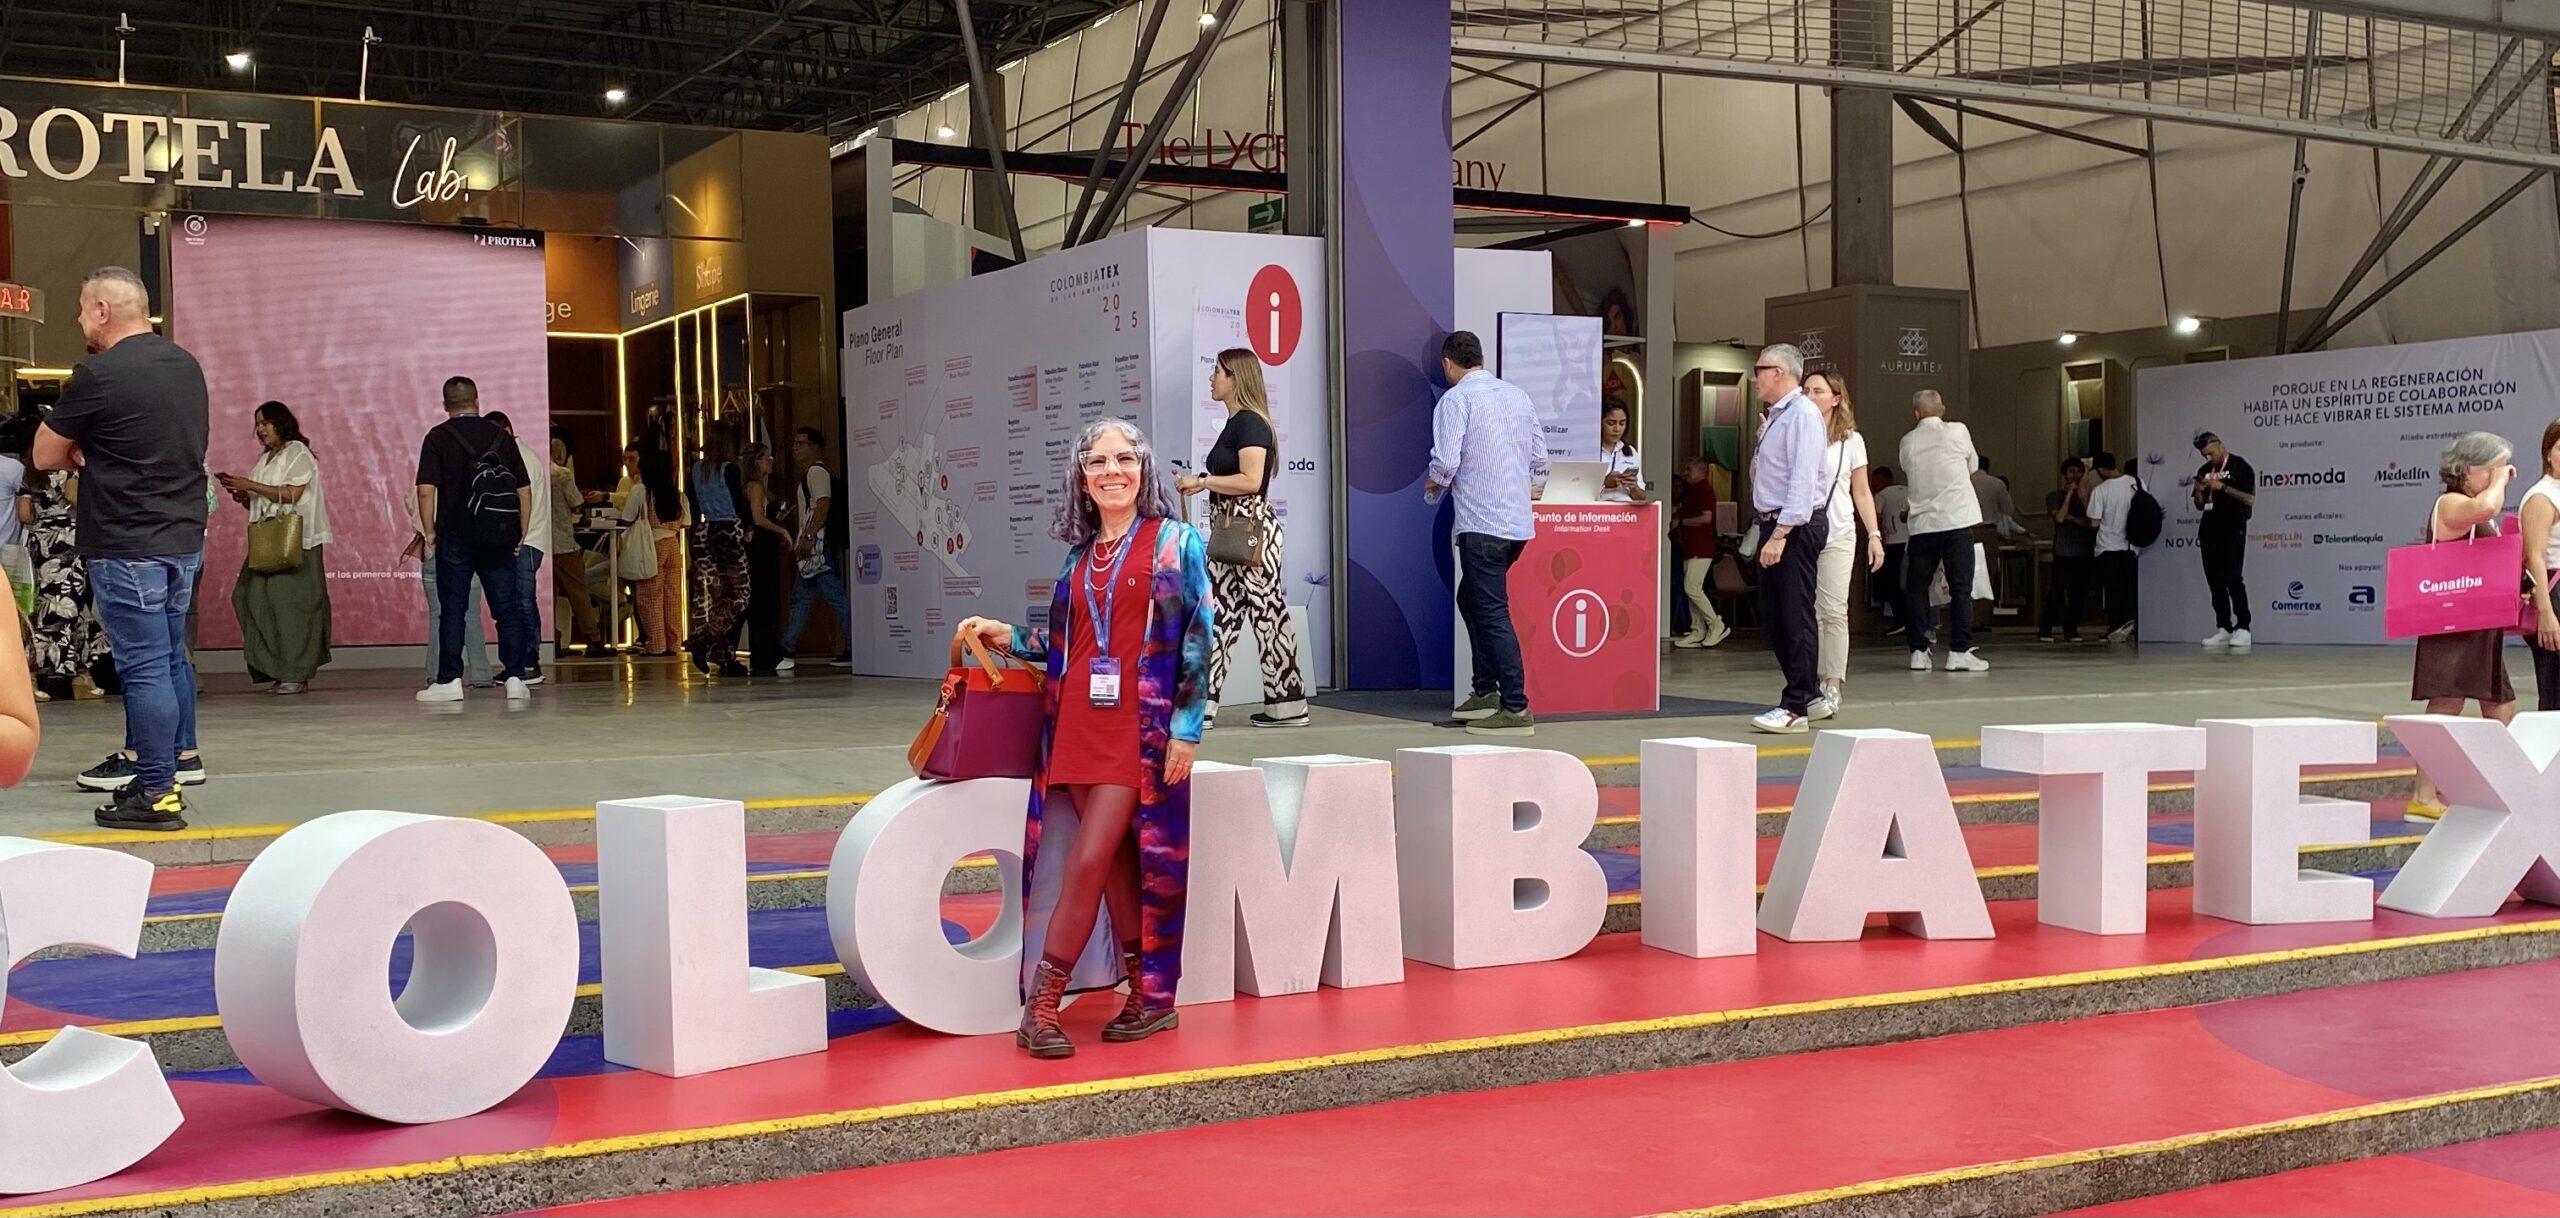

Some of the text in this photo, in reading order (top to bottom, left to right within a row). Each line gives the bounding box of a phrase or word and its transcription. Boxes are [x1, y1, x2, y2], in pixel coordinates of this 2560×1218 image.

[487, 236, 536, 248] PROTELA
[1050, 263, 1119, 293] COLOMBIATEX
[849, 319, 903, 349] Plano General
[865, 343, 904, 366] Floor Plan
[1880, 360, 1943, 374] AURUMTEX
[2272, 366, 2483, 397] PORQUE EN LA REGENERACIÓN
[2243, 379, 2517, 413] HABITA UN ESPÍRITU DE COLABORACIÓN
[2253, 399, 2504, 428] QUE HACE VIBRAR EL SISTEMA MODA
[2259, 467, 2346, 487] inexmoda
[2374, 466, 2430, 482] Medellín
[1533, 511, 1638, 523] Punto de Información
[1554, 523, 1592, 533] Information
[2324, 532, 2384, 544] Teleantioquia
[352, 571, 392, 580] primeros
[2419, 576, 2483, 593] Canatiba
[2271, 600, 2322, 611] Comertex
